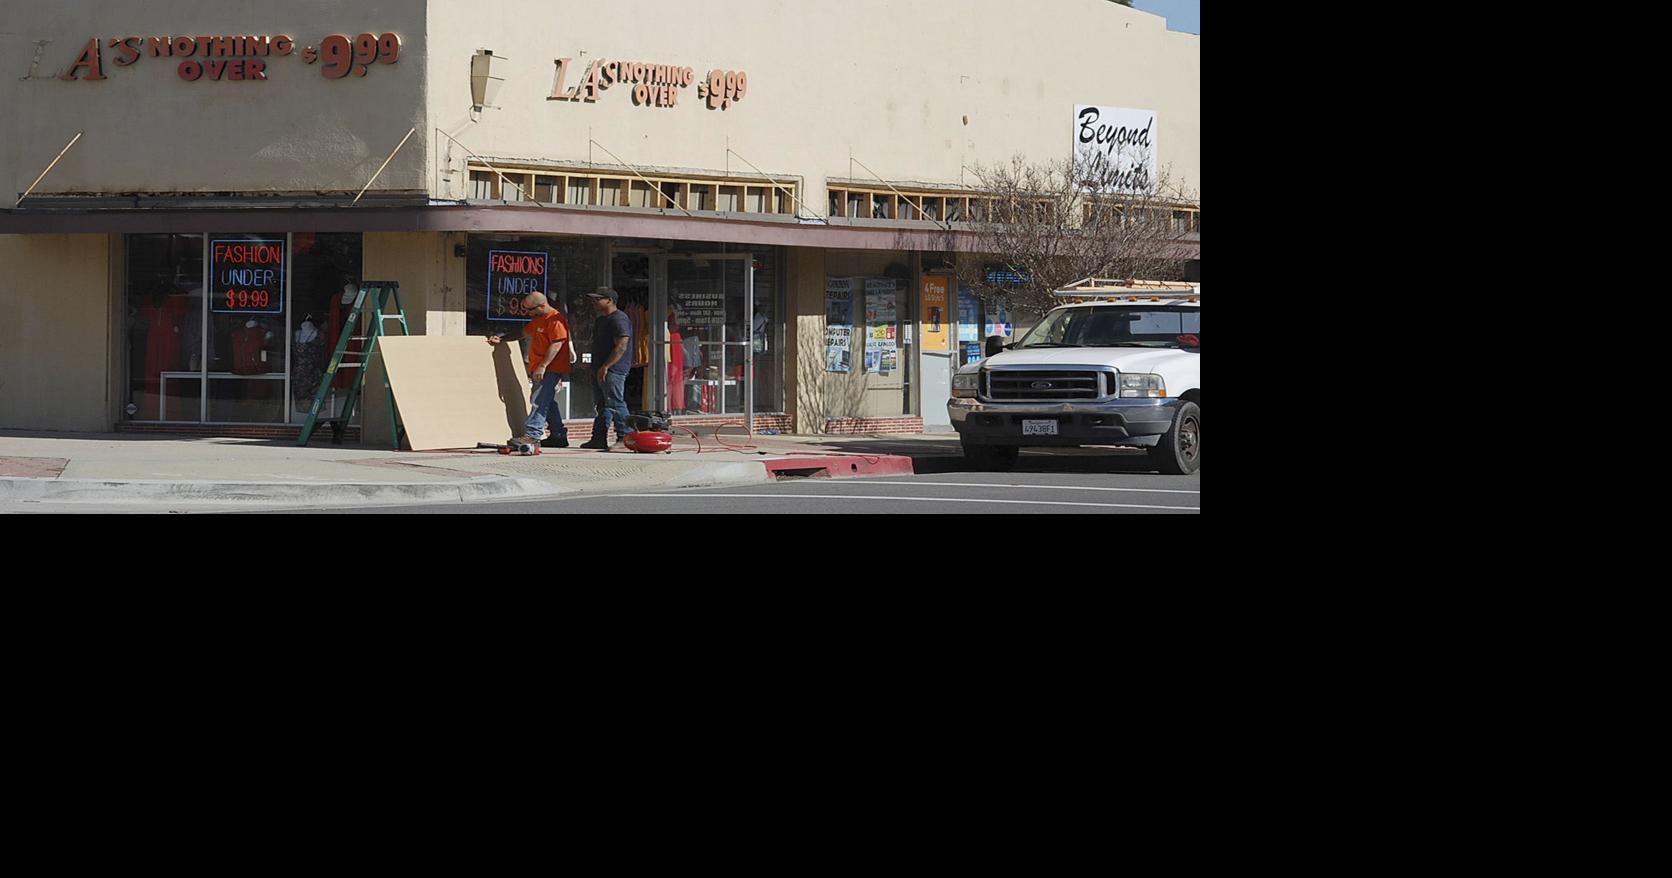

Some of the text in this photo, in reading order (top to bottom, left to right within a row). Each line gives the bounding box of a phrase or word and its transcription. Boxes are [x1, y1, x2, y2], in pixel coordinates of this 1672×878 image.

[148, 33, 296, 58] NOTHING
[302, 32, 402, 80] $9.99
[177, 59, 268, 81] OVER
[617, 61, 695, 88] NOTHING
[632, 84, 678, 108] OVER
[698, 68, 748, 111] $9.99
[1078, 106, 1153, 156] Beyond
[214, 245, 281, 264] FASHION
[491, 254, 544, 275] FASHIONS
[221, 269, 275, 287] UNDER
[498, 277, 538, 295] UNDER
[929, 283, 945, 294] Free
